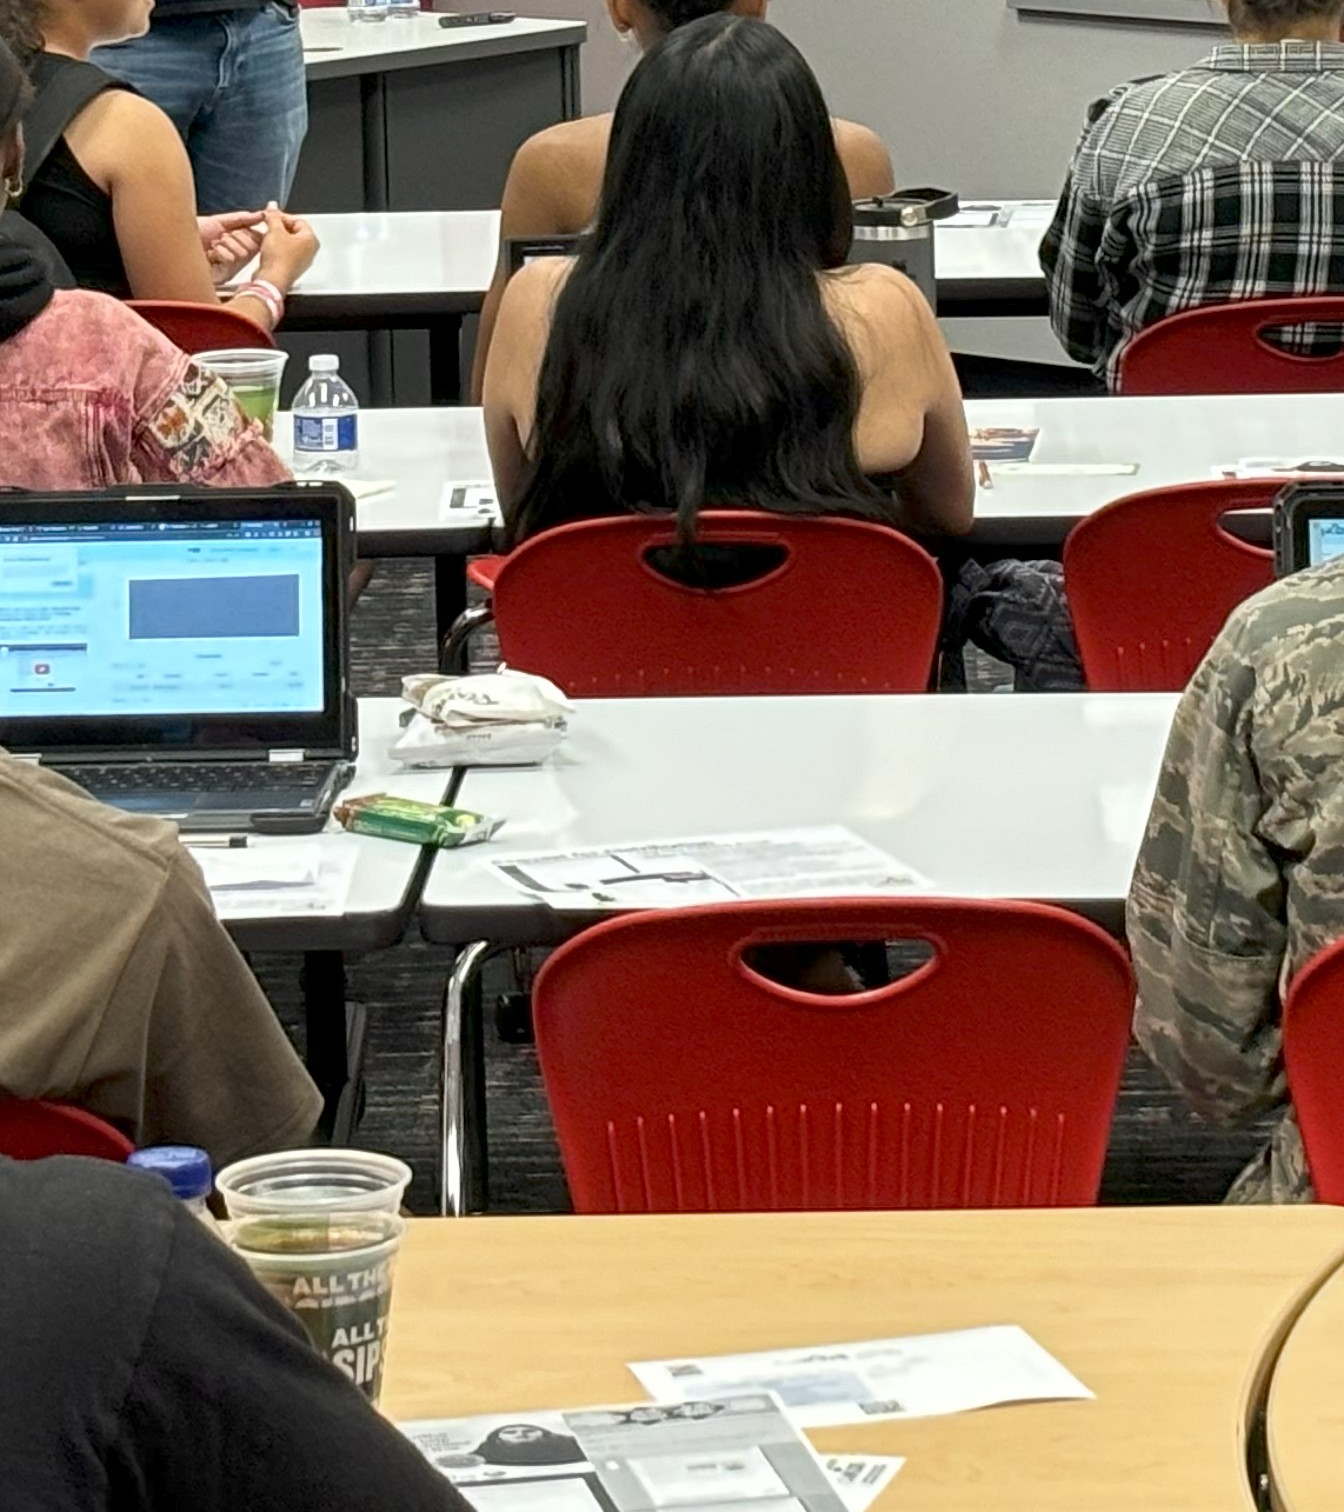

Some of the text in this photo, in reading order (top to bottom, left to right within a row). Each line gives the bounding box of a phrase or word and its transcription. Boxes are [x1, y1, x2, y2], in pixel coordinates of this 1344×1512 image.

[293, 1275, 345, 1297] ALL
[331, 1321, 374, 1350] ALL
[332, 1337, 385, 1386] SIP
